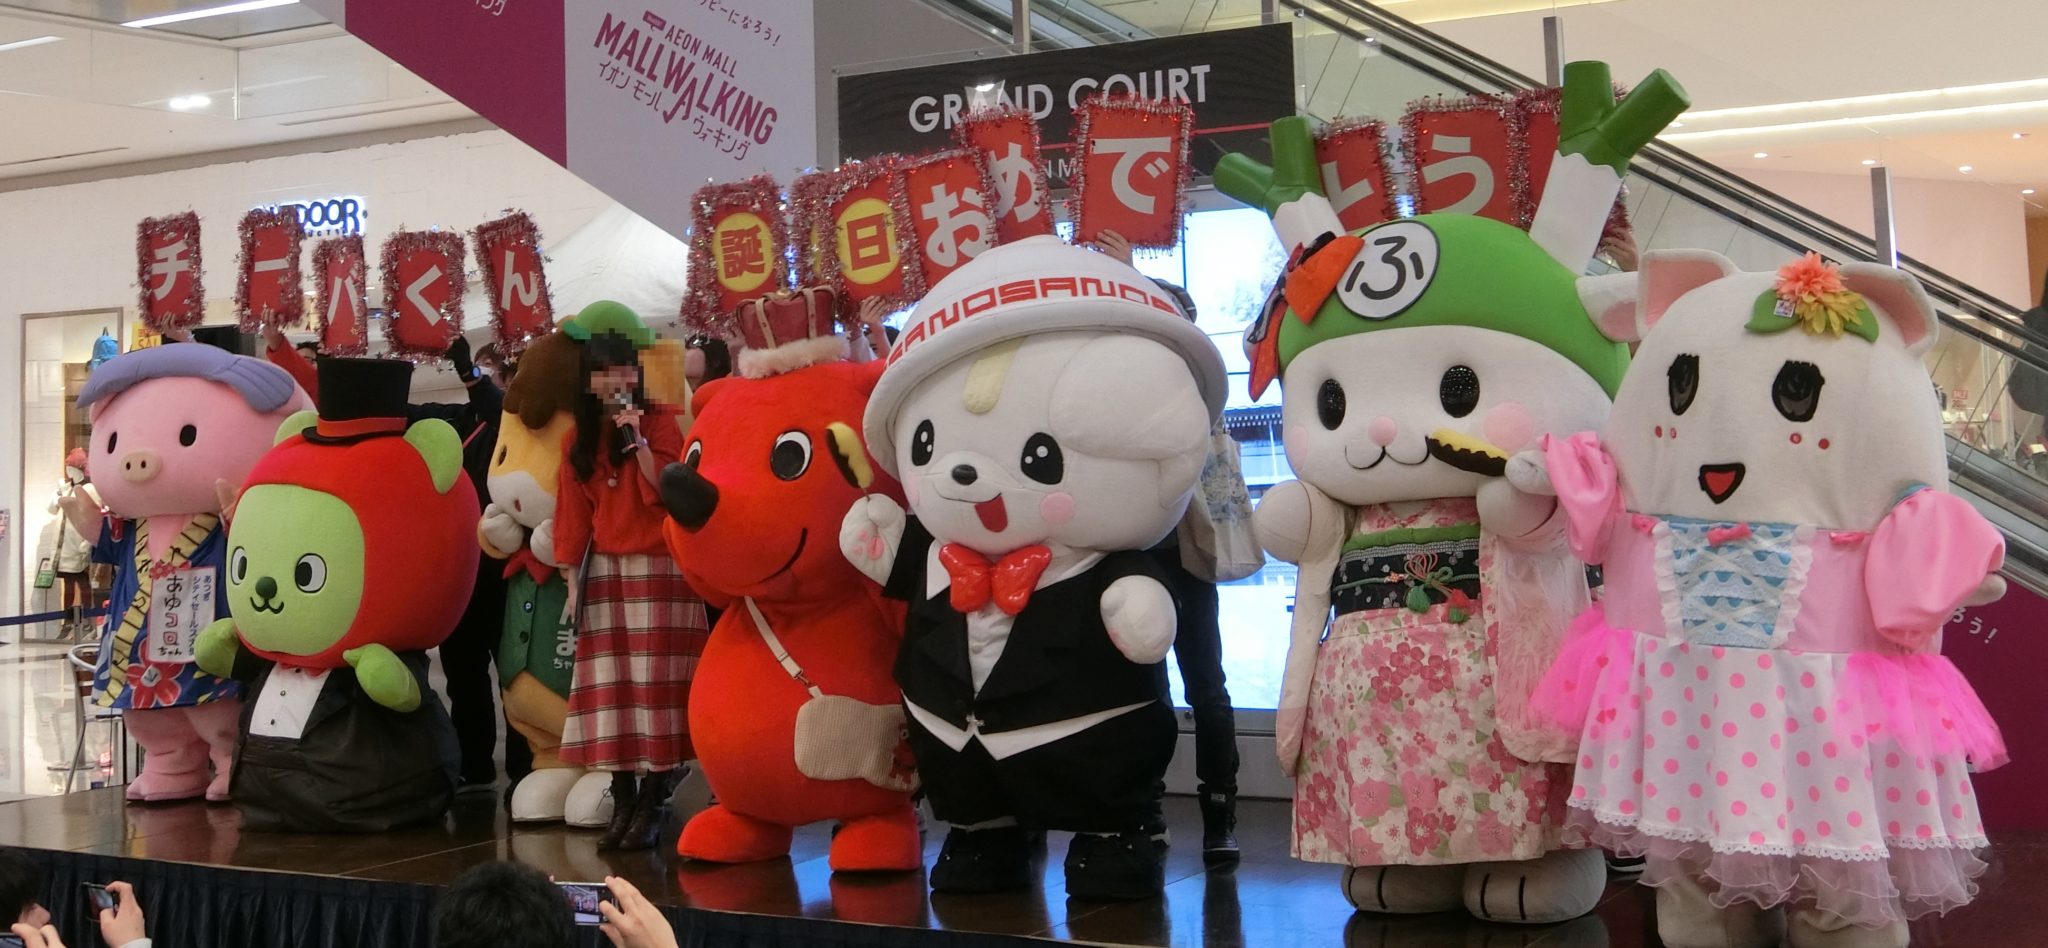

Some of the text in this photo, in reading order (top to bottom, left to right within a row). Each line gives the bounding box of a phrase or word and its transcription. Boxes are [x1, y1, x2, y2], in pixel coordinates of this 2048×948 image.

[665, 25, 738, 78] AEON MALL
[1067, 63, 1211, 112] COURT
[692, 115, 752, 161] ウォーキング
[1344, 235, 1414, 301] ふ
